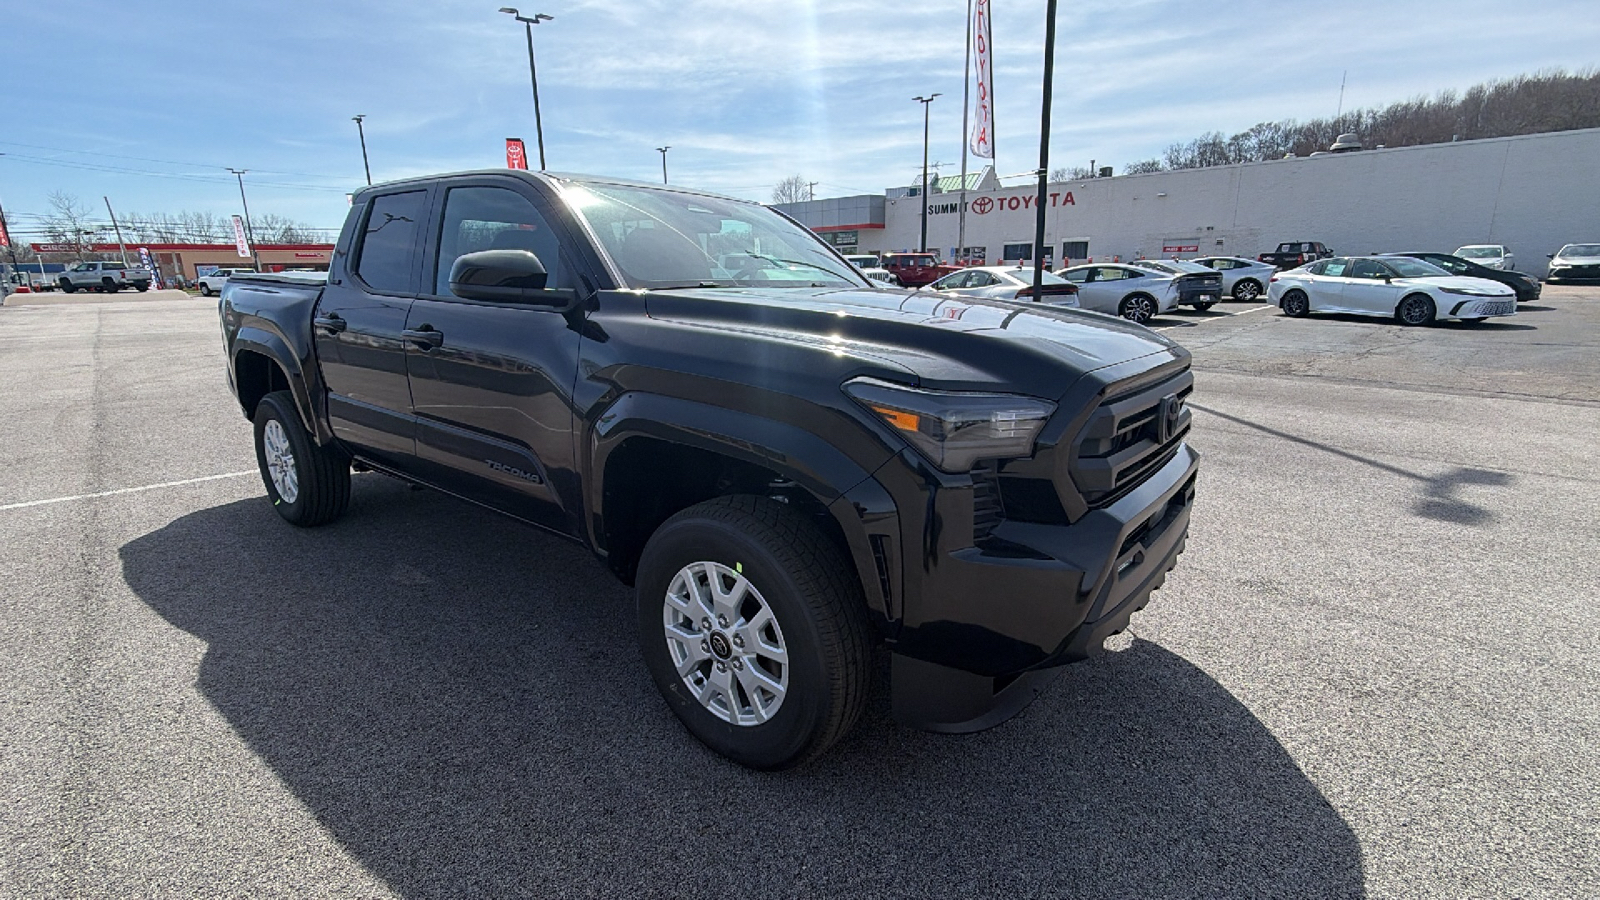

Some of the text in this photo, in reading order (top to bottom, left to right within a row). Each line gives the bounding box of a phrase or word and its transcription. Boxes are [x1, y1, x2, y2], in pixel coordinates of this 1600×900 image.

[977, 11, 987, 145] TOYOTA
[928, 202, 969, 215] SUMMT
[485, 459, 540, 484] TACOMA
